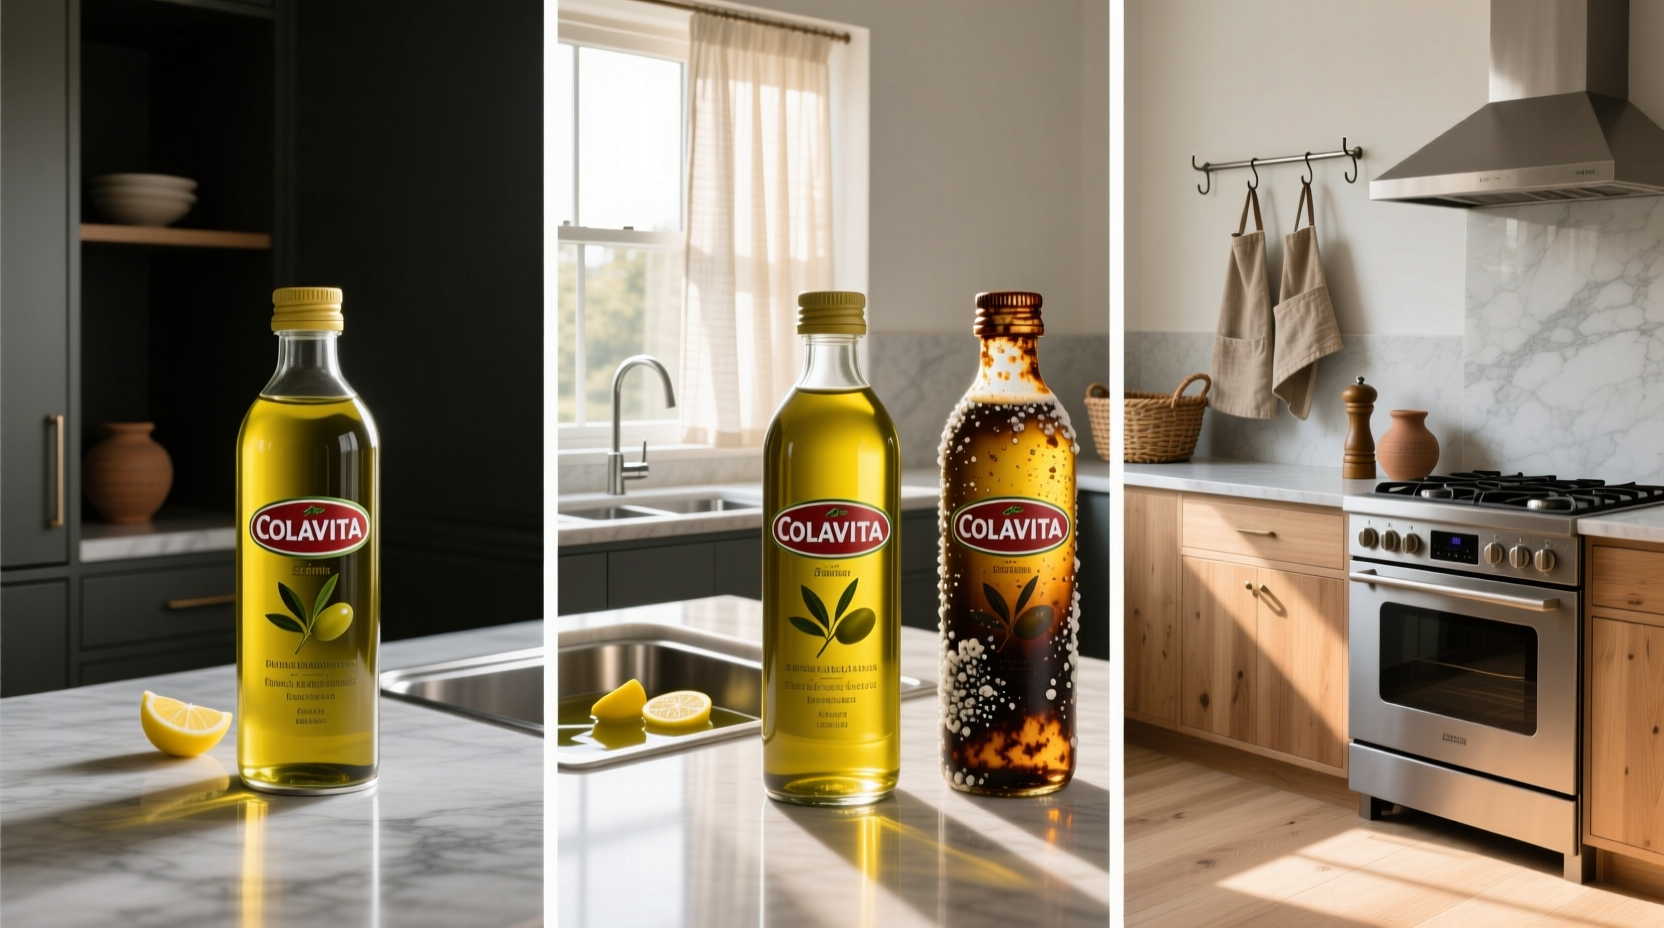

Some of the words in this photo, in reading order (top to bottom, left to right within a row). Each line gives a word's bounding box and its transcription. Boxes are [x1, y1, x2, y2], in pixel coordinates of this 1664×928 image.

[256, 514, 362, 541] COLAVITA
[777, 516, 883, 543] COLAVITA
[959, 514, 1063, 540] COLAVITA
